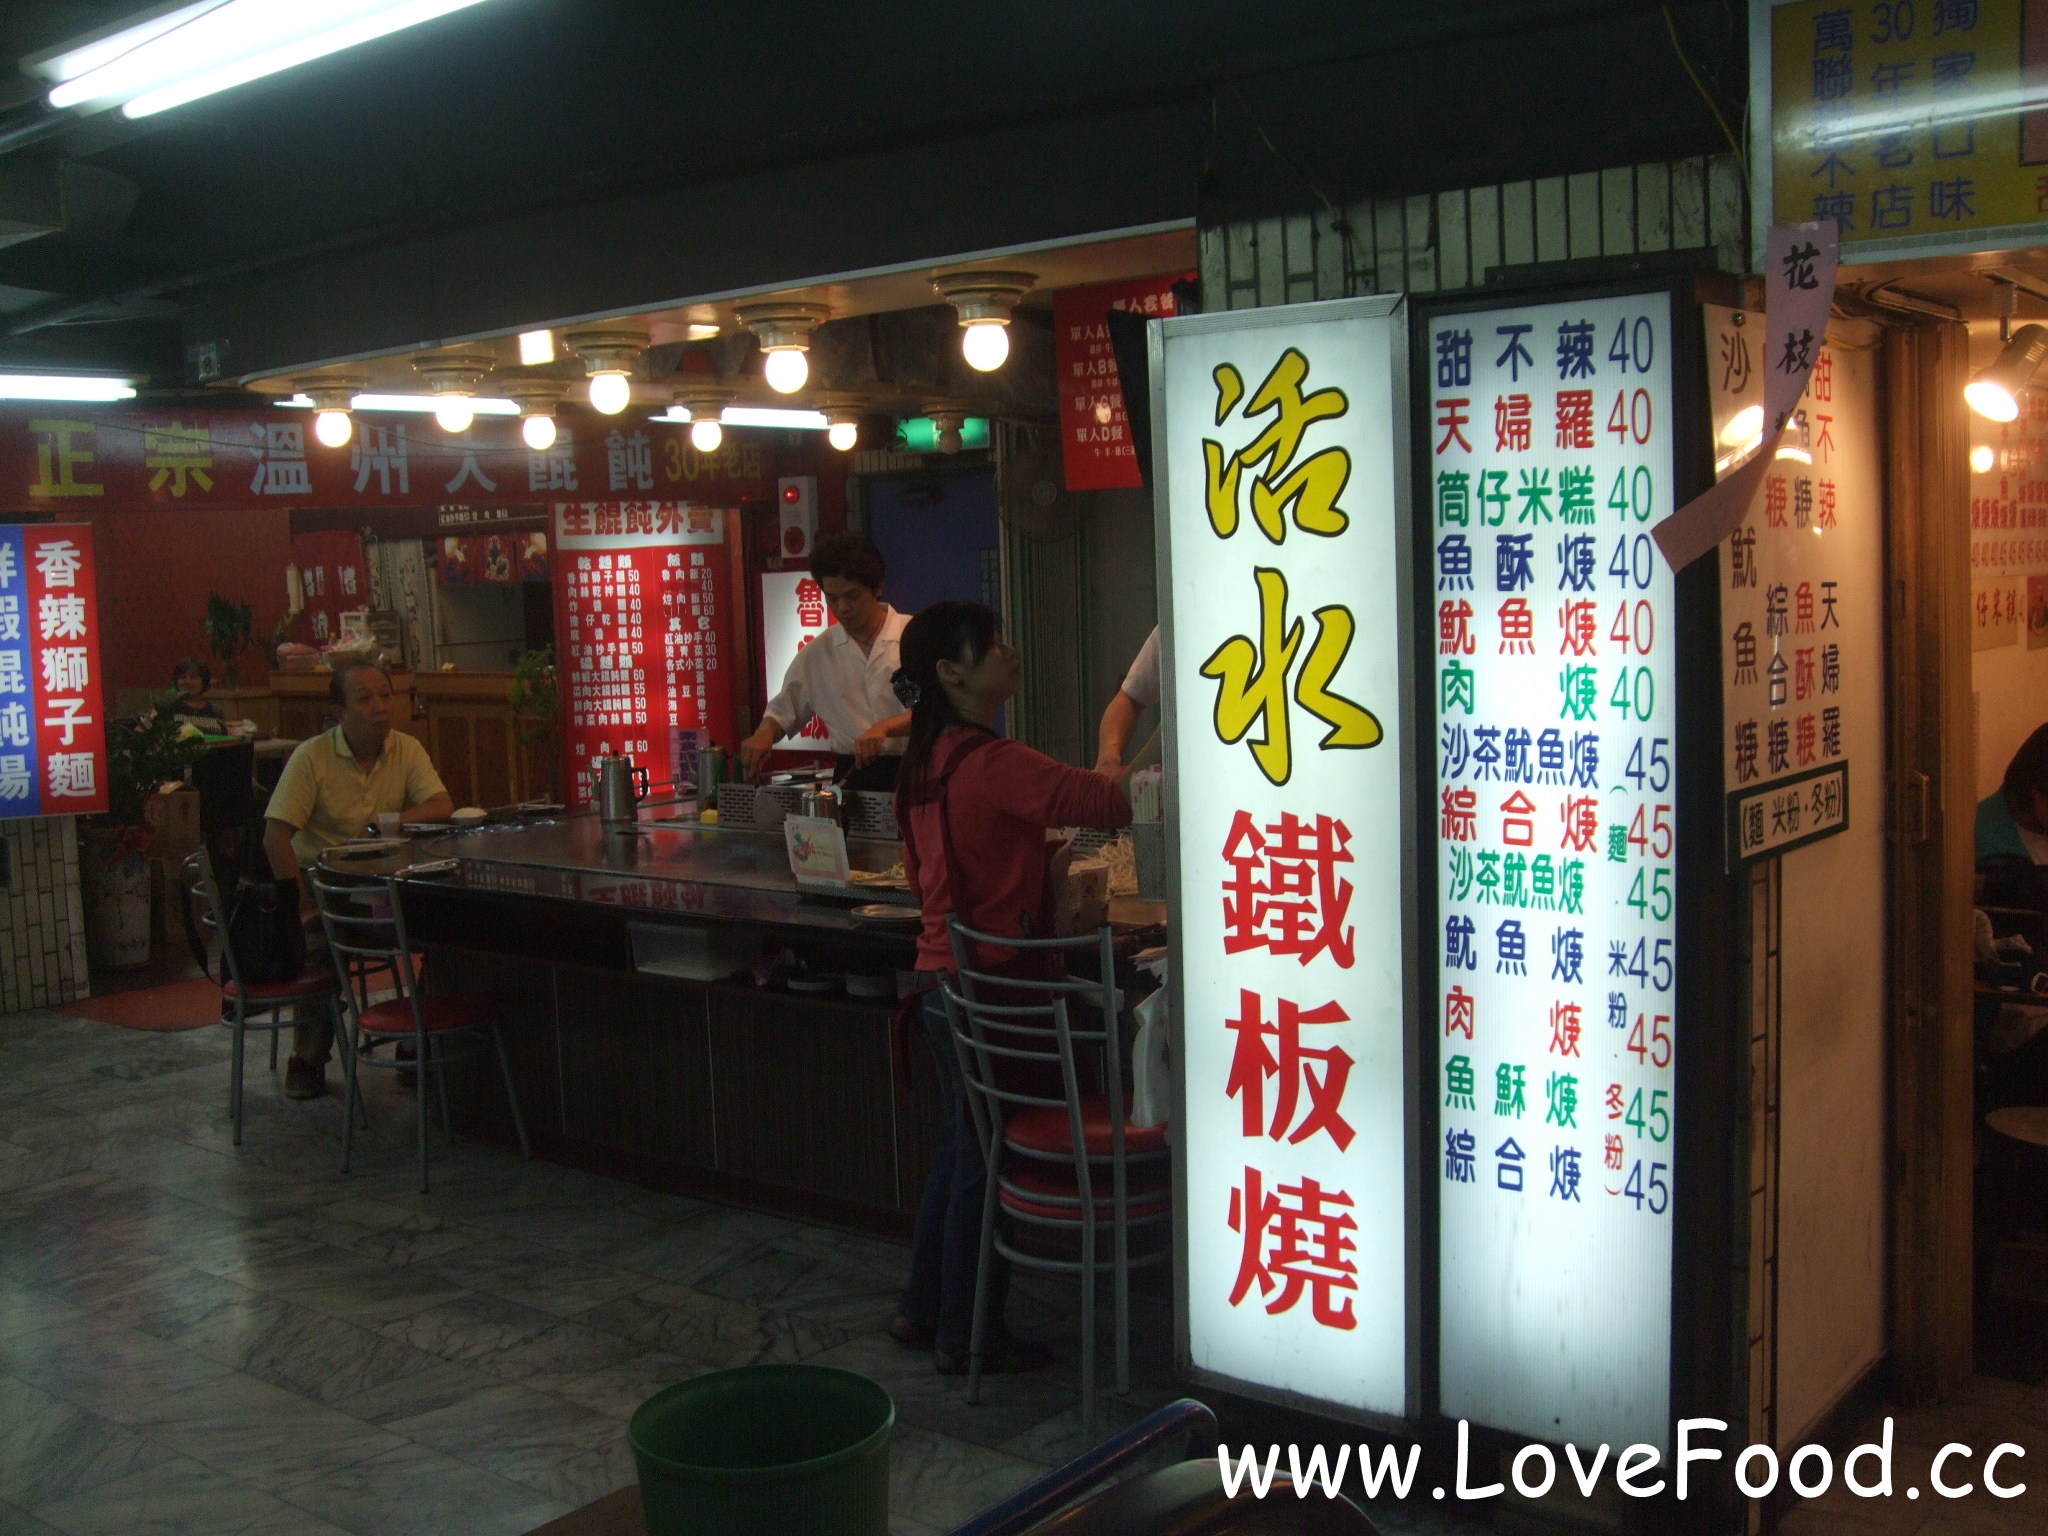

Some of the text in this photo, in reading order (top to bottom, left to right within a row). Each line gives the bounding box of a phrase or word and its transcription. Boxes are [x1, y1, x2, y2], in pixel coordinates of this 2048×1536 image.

[1436, 316, 1654, 387] 甜不辣 40
[1436, 387, 1653, 454] 天婦羅 40
[1436, 466, 1654, 527] 筒仔米糕 40
[1608, 534, 1654, 590] 40
[1609, 600, 1655, 655] 40
[35, 540, 97, 798] 香辣獅子麵
[1610, 666, 1655, 722] 40
[1821, 581, 1841, 758] 天婦羅
[1625, 738, 1671, 793] 45
[1627, 804, 1673, 859] 45
[1627, 866, 1672, 921] 45
[1628, 937, 1673, 992] 45
[1627, 1013, 1672, 1068] 45
[1625, 1088, 1670, 1143] 45
[1624, 1160, 1669, 1215] 45
